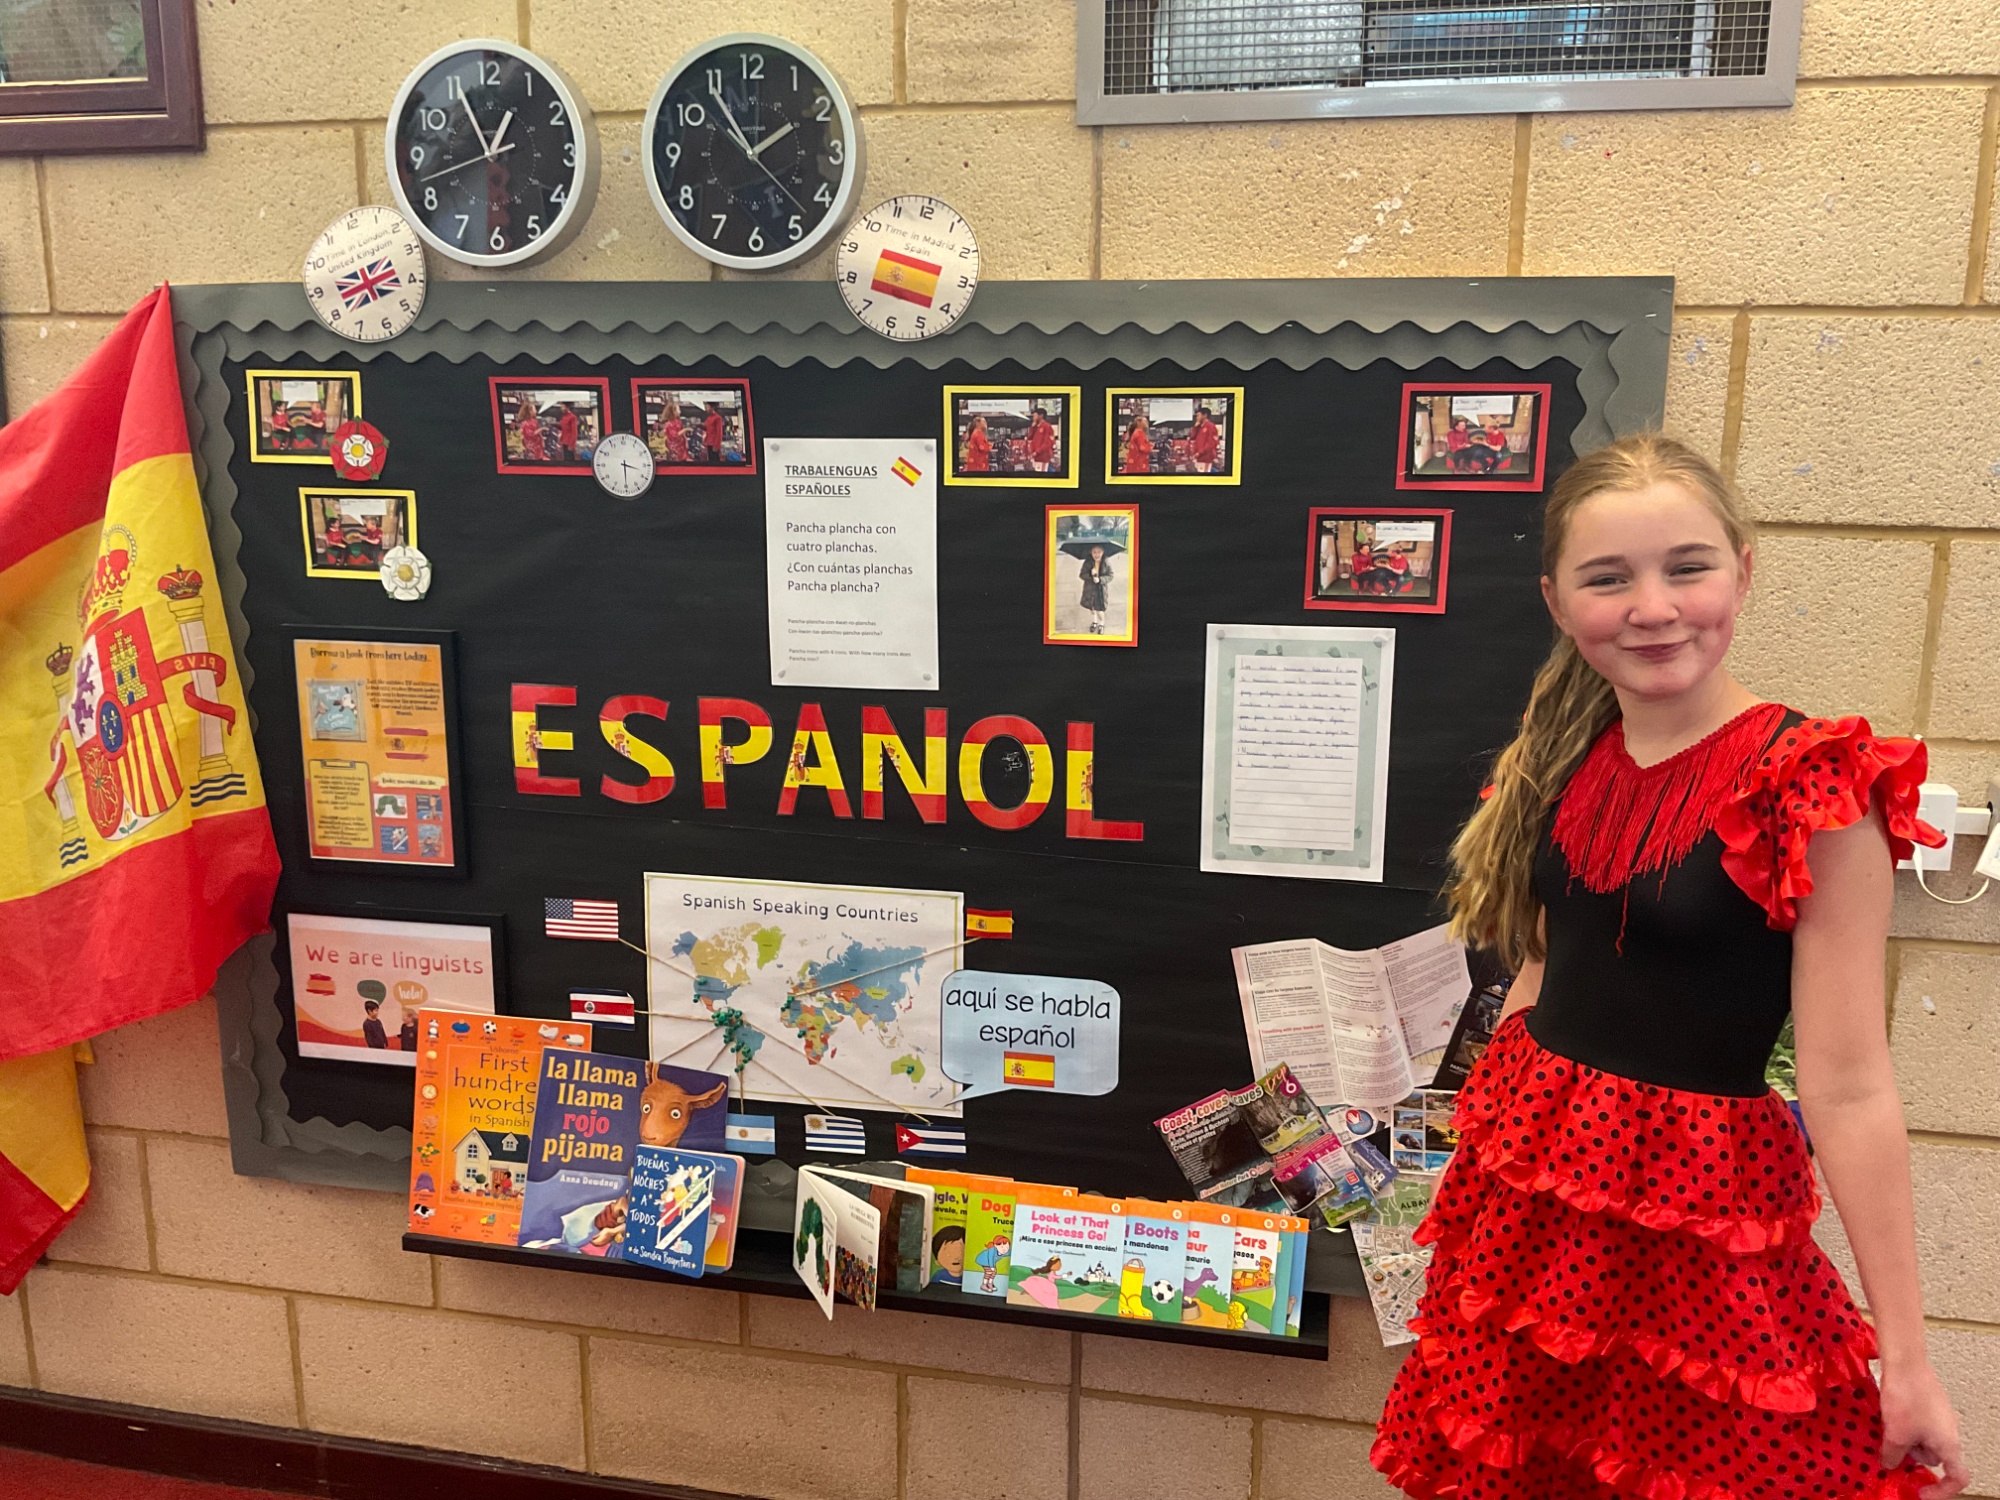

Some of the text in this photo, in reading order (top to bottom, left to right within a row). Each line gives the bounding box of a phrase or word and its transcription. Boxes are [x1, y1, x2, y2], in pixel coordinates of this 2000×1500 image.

[477, 61, 500, 85] 12
[740, 54, 764, 79] 12
[525, 72, 532, 96] 1
[706, 69, 721, 94] 11
[790, 66, 797, 91] 1
[446, 76, 461, 99] 11
[549, 101, 564, 125] 2
[677, 104, 705, 126] 10
[815, 96, 831, 121] 2
[420, 109, 446, 130] 10
[410, 146, 424, 170] 9
[563, 143, 576, 167] 3
[666, 143, 681, 167] 9
[829, 140, 843, 165] 3
[424, 187, 438, 210] 8
[550, 184, 567, 209] 4
[679, 185, 694, 209] 8
[814, 183, 832, 207] 4
[375, 214, 378, 224] 1
[893, 206, 901, 218] 11
[920, 205, 934, 220] 12
[347, 219, 358, 230] 12
[392, 222, 401, 234] 2
[455, 215, 469, 239] 7
[527, 216, 541, 239] 5
[712, 214, 726, 239] 7
[788, 216, 802, 240] 5
[866, 220, 881, 232] 10
[949, 222, 954, 233] 1
[326, 236, 334, 245] 11
[490, 226, 504, 250] 6
[749, 227, 764, 251] 6
[885, 224, 908, 237] Time
[923, 235, 956, 252] Madrid,
[326, 250, 345, 262] Time
[404, 244, 414, 256] 3
[848, 242, 859, 253] 9
[904, 243, 931, 257] Spain
[959, 247, 970, 259] 2
[312, 258, 325, 270] 10
[328, 240, 393, 273] United Kingdom
[408, 273, 416, 284] 4
[847, 271, 857, 284] 8
[958, 276, 968, 288] 3
[314, 287, 324, 298] 9
[400, 299, 410, 312] 5
[863, 299, 873, 311] 7
[939, 303, 951, 314] 4
[331, 309, 341, 321] 8
[382, 317, 392, 329] 6
[886, 316, 897, 328] 6
[915, 316, 926, 329] 5
[355, 320, 363, 332] 7
[785, 465, 878, 476] TRABALENGUAS
[785, 482, 851, 495] ESPAÑOLES
[786, 523, 896, 535] Pancha plancha con
[786, 542, 877, 554] cuatro planchas.
[787, 562, 913, 576] ¿Con cuántas planchas
[788, 581, 880, 593] Pancha plancha?
[346, 649, 363, 659] book
[683, 893, 919, 923] Spanish Speaking Countries
[306, 944, 484, 975] We are linguists
[946, 987, 1110, 1019] aquí se habla
[980, 1024, 1074, 1048] español
[480, 1053, 529, 1072] First
[455, 1067, 537, 1093] hundre
[547, 1056, 637, 1088] la llama
[1287, 1082, 1297, 1093] 6
[469, 1095, 535, 1114] words
[557, 1083, 623, 1110] llama
[470, 1114, 530, 1127] in Spanish
[1162, 1110, 1196, 1132] Coast,
[1196, 1095, 1229, 1117] coves
[563, 1109, 609, 1137] rojo
[542, 1134, 623, 1162] pijama
[637, 1155, 670, 1172] BUENAS
[560, 1174, 618, 1190] Anna Dewdney
[634, 1175, 665, 1190] NOCHES
[641, 1195, 647, 1206] A
[982, 1199, 1011, 1217] Dog
[630, 1209, 656, 1225] TODOS
[993, 1217, 1014, 1225] Truco
[1031, 1211, 1109, 1229] Look at That
[1032, 1224, 1106, 1241] Princess Go!
[1134, 1222, 1179, 1240] Boots
[1056, 1240, 1084, 1248] princesa
[1130, 1241, 1169, 1251] mandonas
[1235, 1232, 1267, 1249] Cars
[640, 1246, 661, 1262] Sandra
